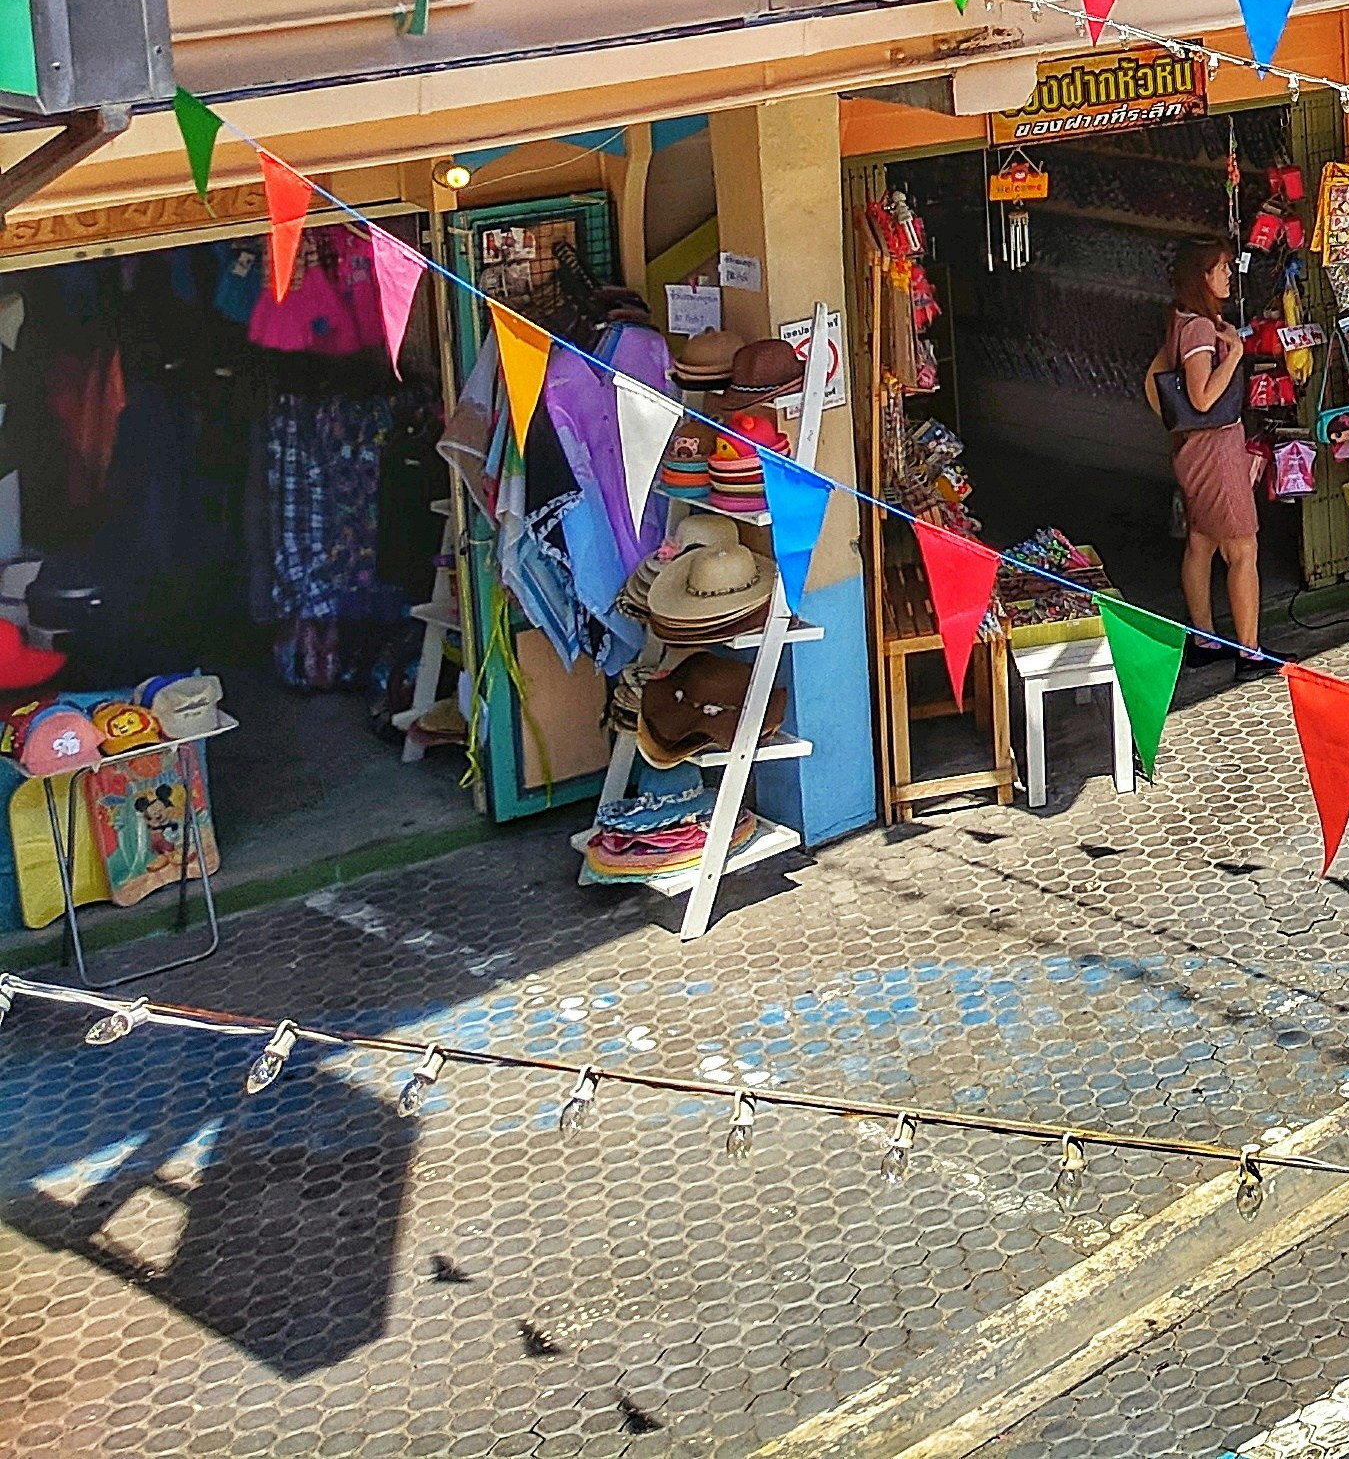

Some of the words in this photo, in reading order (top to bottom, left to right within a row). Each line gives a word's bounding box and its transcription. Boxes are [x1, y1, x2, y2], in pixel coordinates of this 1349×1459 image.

[1008, 57, 1195, 115] งฝากหัวหิน
[1014, 102, 1183, 138] ของฝากที่ระลึก
